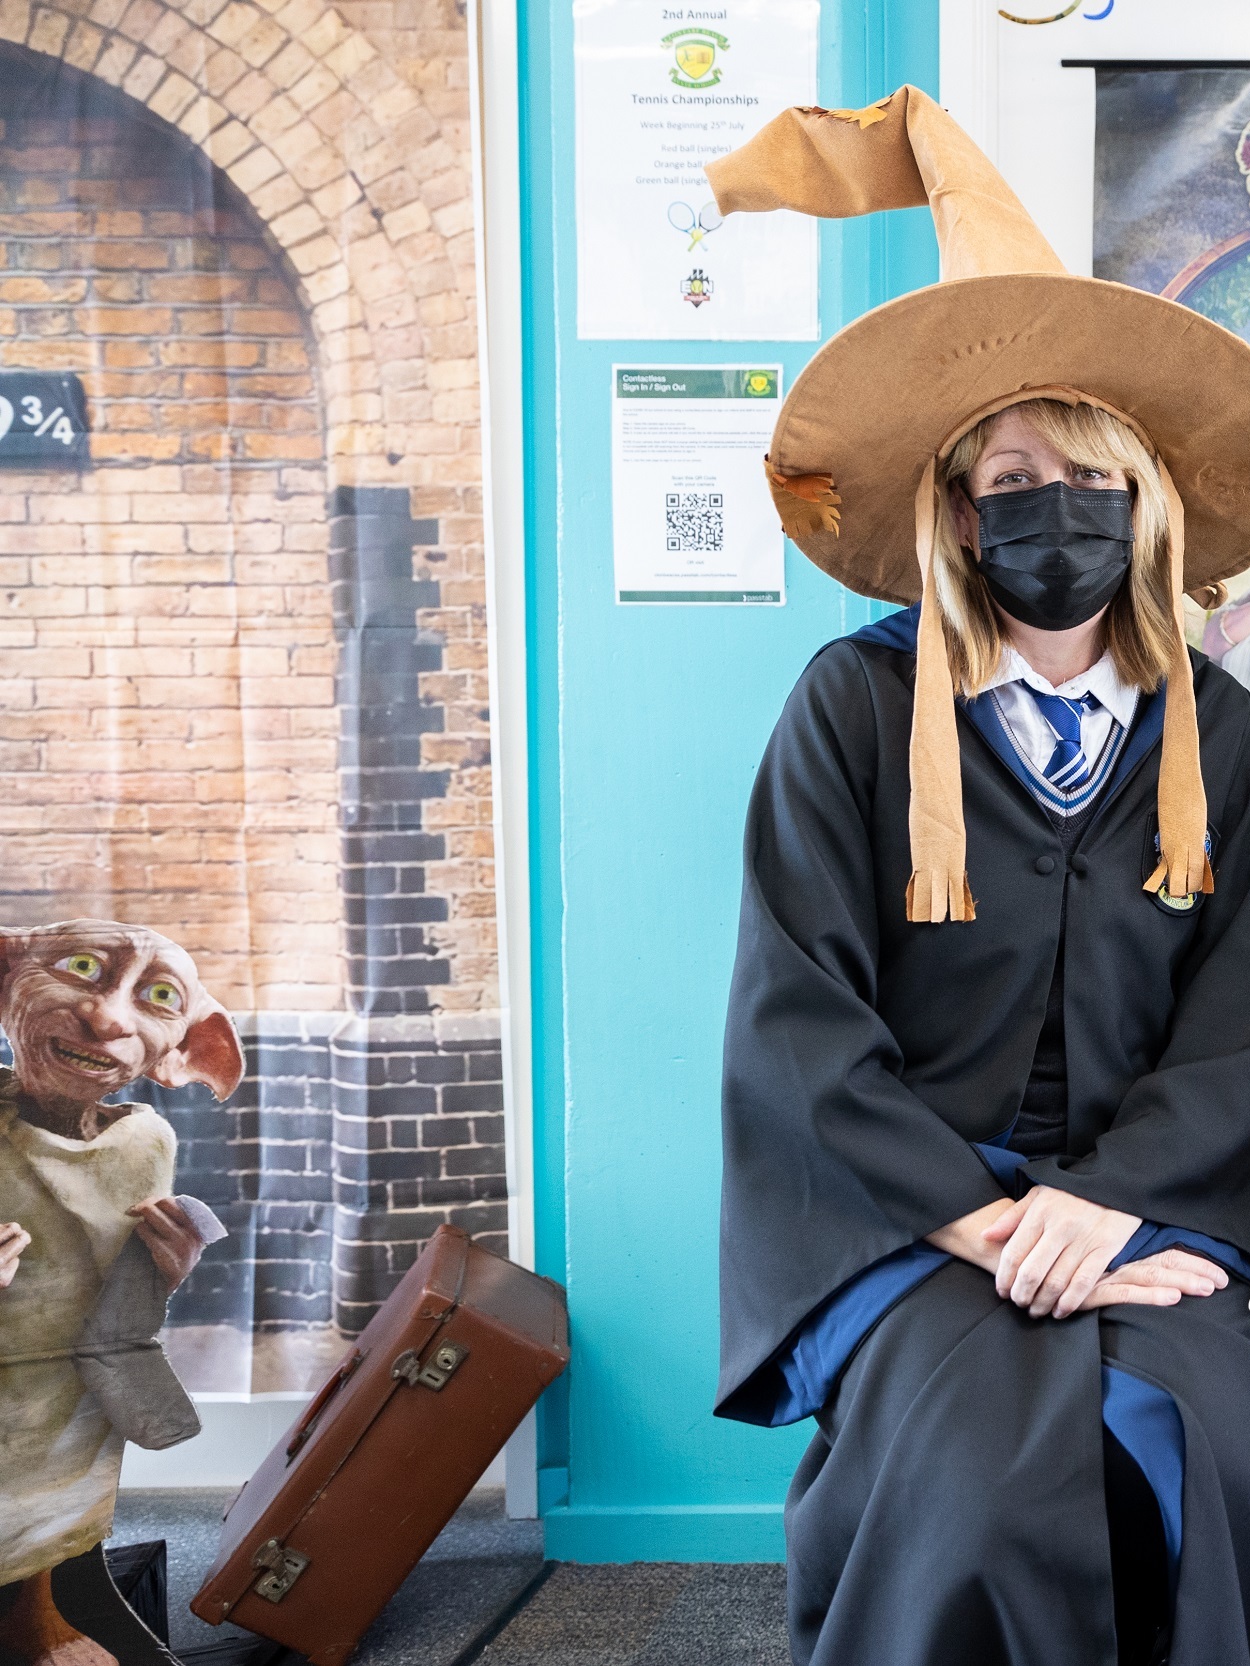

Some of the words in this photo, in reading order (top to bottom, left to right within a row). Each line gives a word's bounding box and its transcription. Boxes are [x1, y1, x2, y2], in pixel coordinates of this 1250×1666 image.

[662, 9, 684, 20] 2nd
[687, 9, 728, 20] Annual
[631, 94, 668, 105] Tennis
[672, 94, 760, 107] Championships
[640, 121, 664, 130] Week
[667, 121, 708, 131] Beginning
[729, 122, 745, 131] July
[661, 144, 678, 152] Red
[680, 144, 696, 152] ball
[697, 144, 732, 155] (singles)
[654, 160, 685, 170] Orange
[687, 160, 702, 168] ball
[635, 176, 662, 185] Green
[664, 176, 679, 185] ball
[681, 176, 709, 186] (single
[622, 374, 666, 383] Contactless
[622, 382, 640, 392] Sign
[640, 383, 648, 391] In
[654, 382, 671, 392] Sign
[672, 382, 686, 392] Out
